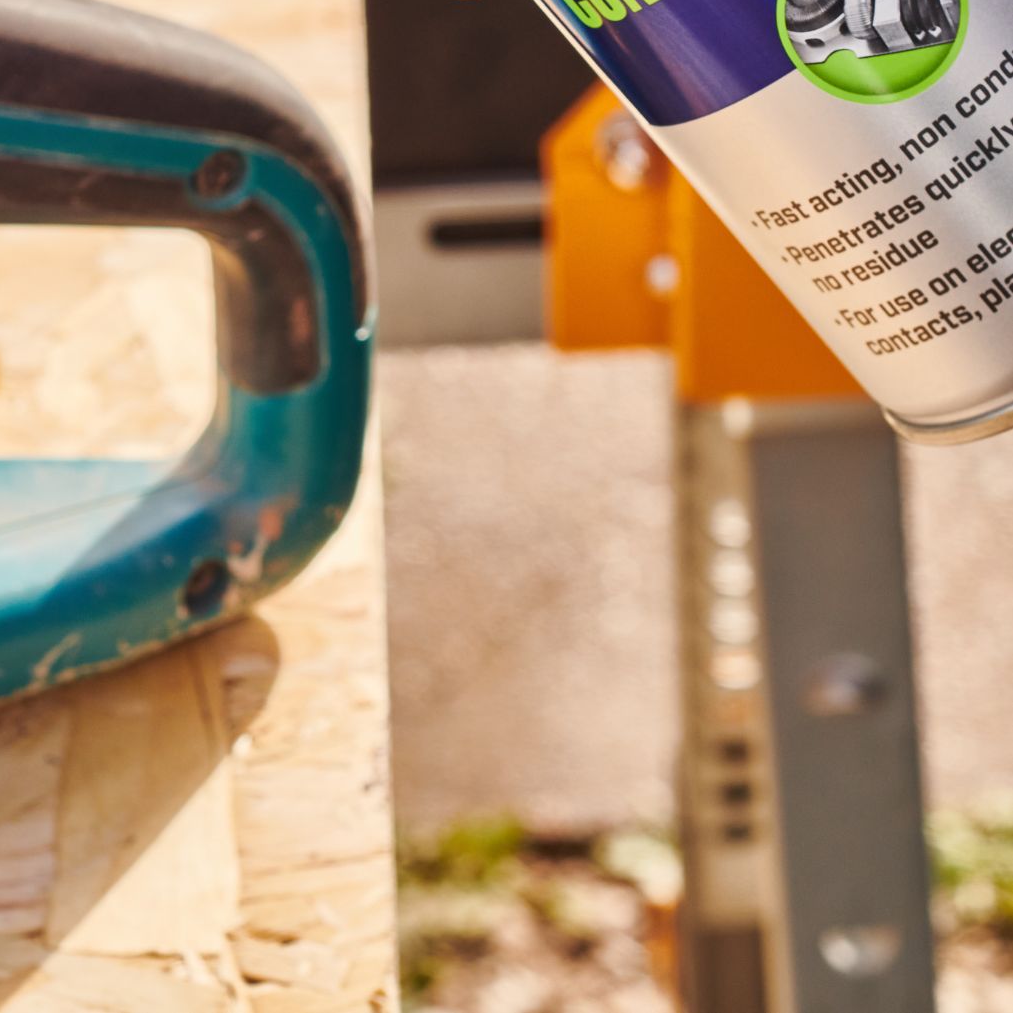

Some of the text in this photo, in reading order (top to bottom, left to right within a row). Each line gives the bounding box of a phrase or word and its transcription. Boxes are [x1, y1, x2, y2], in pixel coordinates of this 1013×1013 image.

[755, 200, 810, 230] Fast
[808, 157, 903, 214] acting,
[899, 113, 957, 162] non
[785, 194, 926, 266] Penetrates
[811, 229, 939, 294] no residue
[839, 308, 878, 329] For
[879, 288, 929, 319] use
[928, 267, 968, 297] on
[865, 303, 983, 356] contacts,
